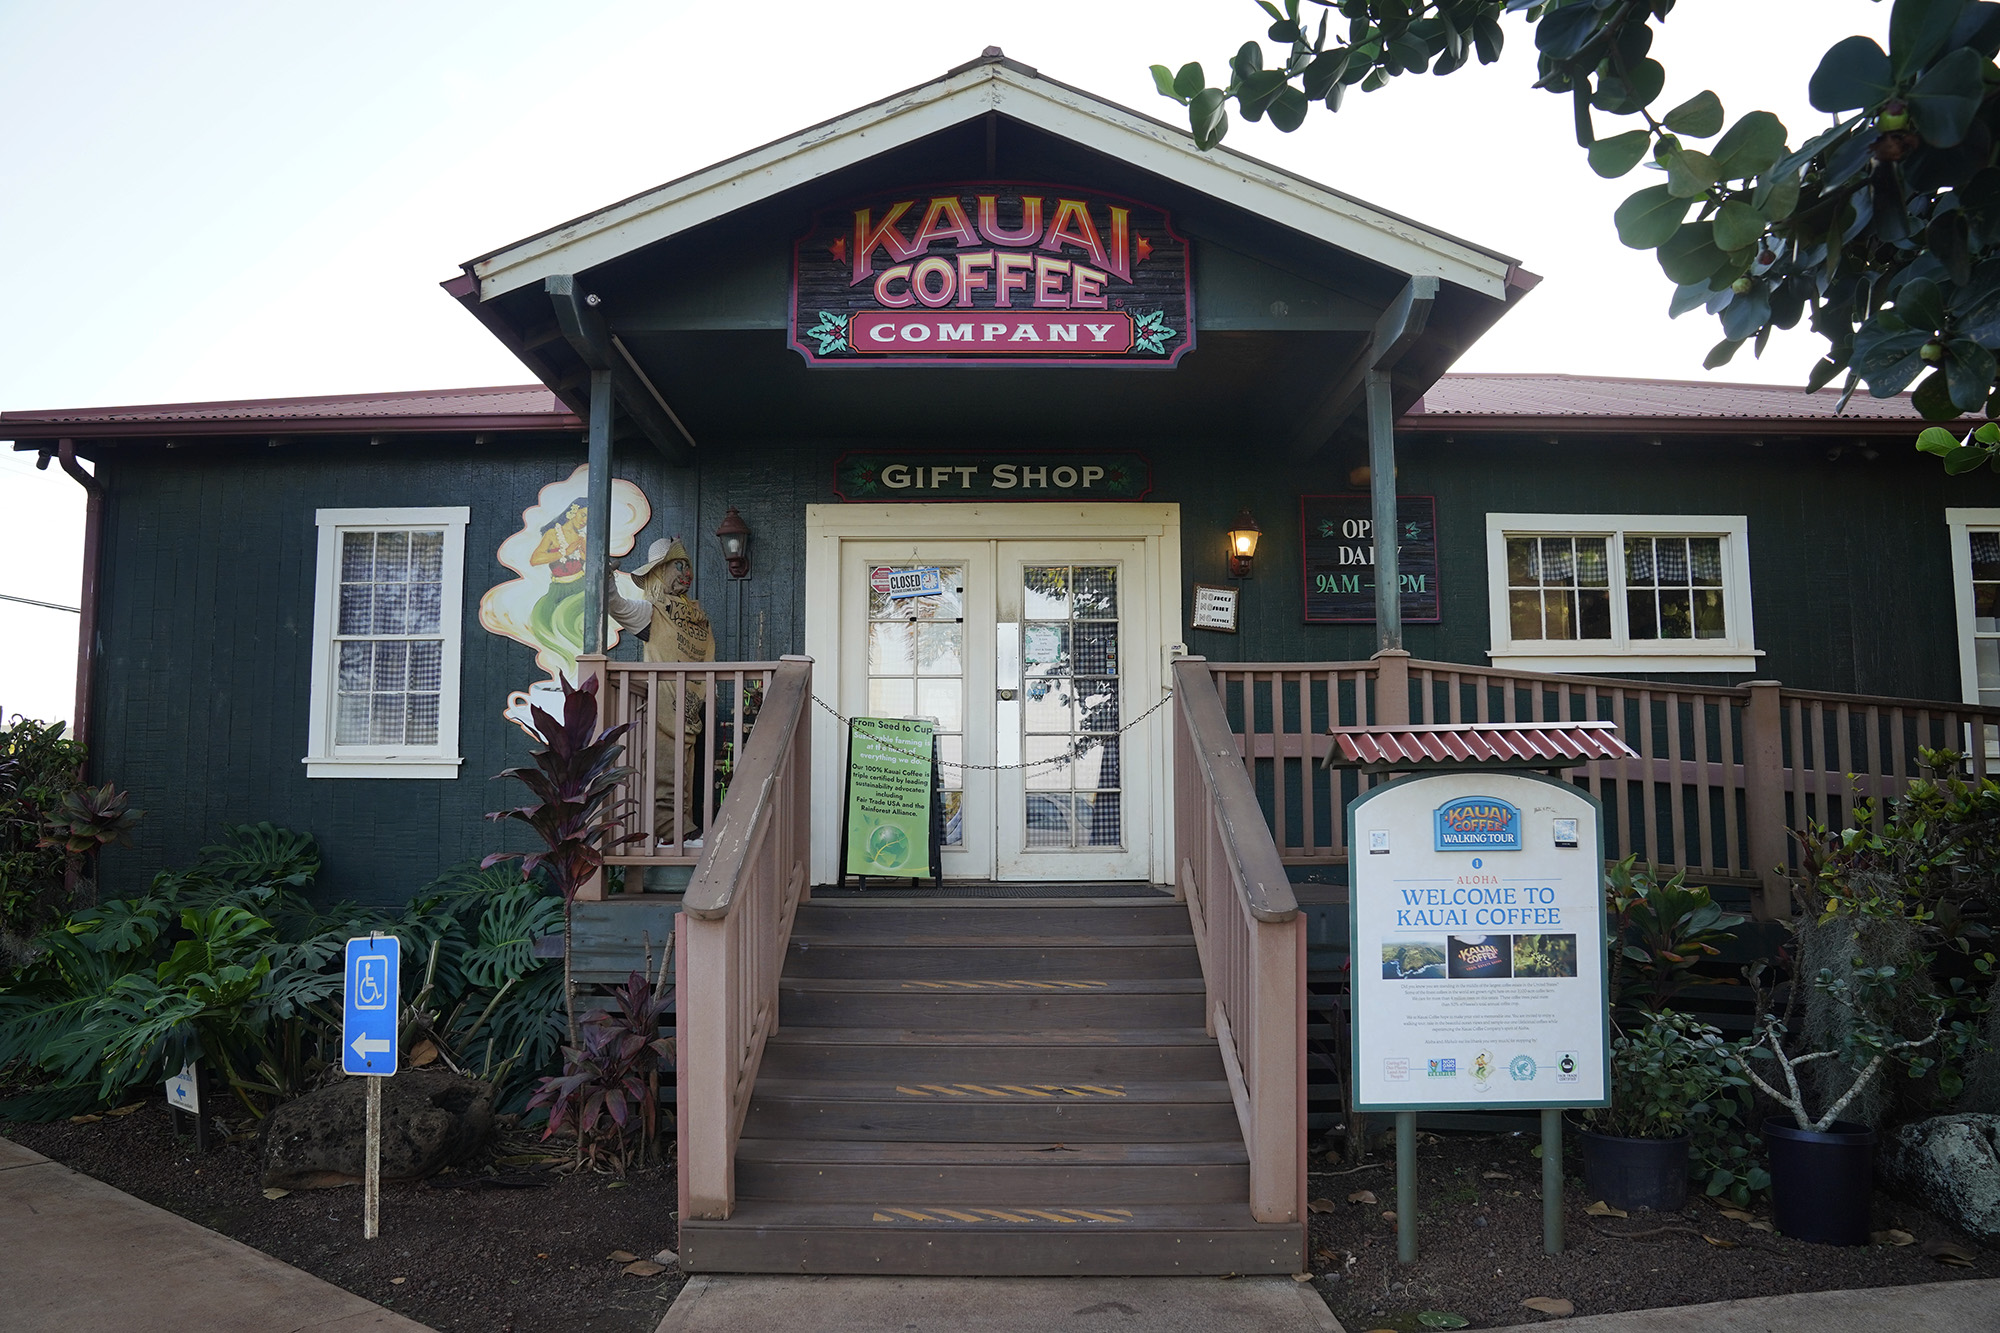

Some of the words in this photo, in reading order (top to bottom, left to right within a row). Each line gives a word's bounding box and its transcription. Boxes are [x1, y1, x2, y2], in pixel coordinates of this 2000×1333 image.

[849, 193, 1133, 288] KAUAI
[873, 249, 1109, 310] COFFEE
[869, 323, 1115, 343] COMPANY
[881, 464, 978, 489] GIFT
[991, 464, 1104, 489] SHOP
[891, 574, 920, 589] CLOSED
[1316, 574, 1360, 594] 9AM
[1201, 593, 1214, 601] NO
[1200, 603, 1213, 611] NO
[1200, 614, 1212, 622] NO
[853, 718, 875, 727] From
[878, 721, 900, 730] Seed
[914, 725, 932, 735] Cup
[895, 736, 923, 747] farming
[860, 752, 897, 763] everything
[910, 757, 922, 765] do.
[865, 765, 882, 773] 100%
[856, 781, 894, 791] sustainability
[895, 785, 925, 793] advocates
[870, 774, 895, 782] certified
[905, 778, 928, 787] leading
[869, 797, 886, 805] Trade
[876, 791, 903, 800] including
[861, 805, 890, 814] Rainforest
[892, 809, 917, 817] Alliance.
[1449, 806, 1508, 826] KAUAI
[1454, 819, 1503, 832] COFFEE
[1443, 833, 1487, 843] WALKING
[1488, 833, 1515, 843] TOUR
[1457, 876, 1498, 884] ALOHA
[1401, 888, 1516, 905] WELCOME
[1523, 887, 1555, 904] TO
[1396, 909, 1468, 926] KAUAI
[1475, 908, 1561, 925] COFFEE
[1459, 945, 1498, 961] KAUAI
[1467, 952, 1497, 964] COFFEE
